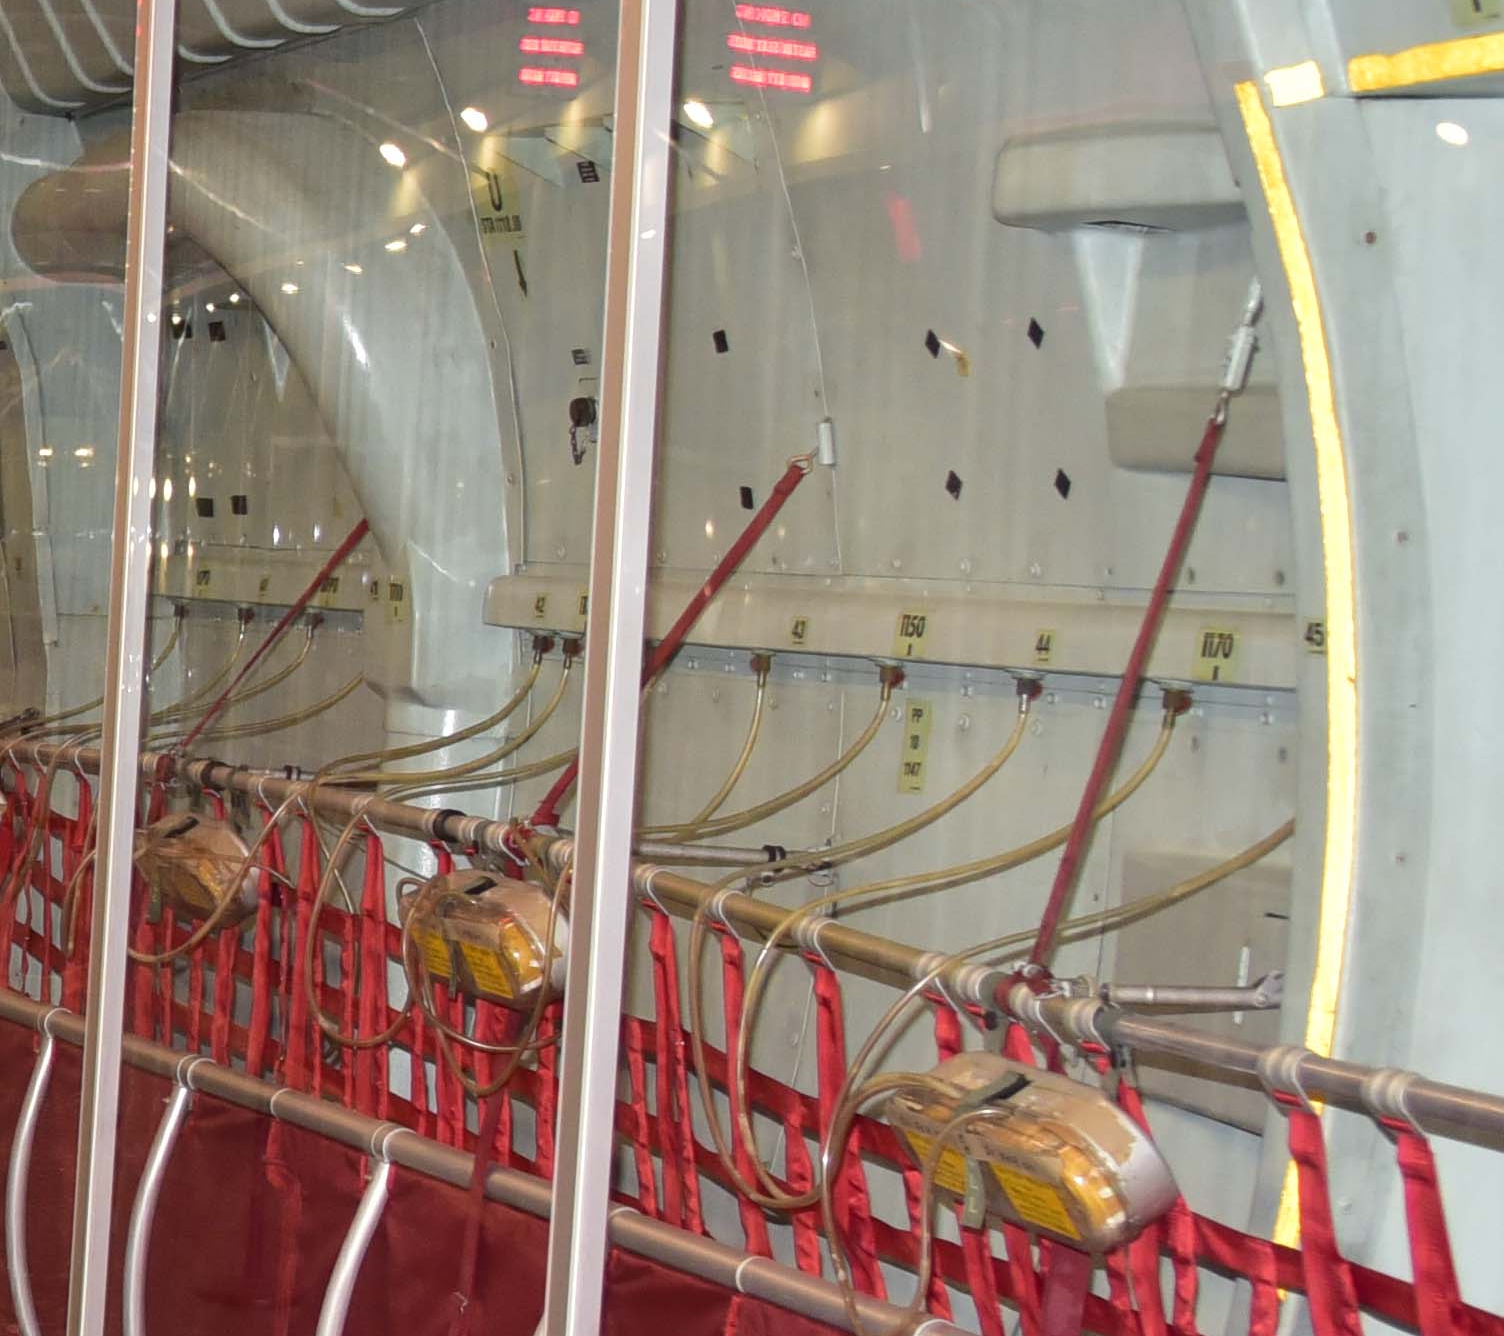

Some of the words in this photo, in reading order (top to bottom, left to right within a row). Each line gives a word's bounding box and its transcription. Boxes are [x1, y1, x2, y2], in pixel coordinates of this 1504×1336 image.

[900, 614, 926, 639] 1150
[1303, 621, 1326, 648] 45
[1035, 633, 1052, 653] 44
[1201, 632, 1234, 660] 1170
